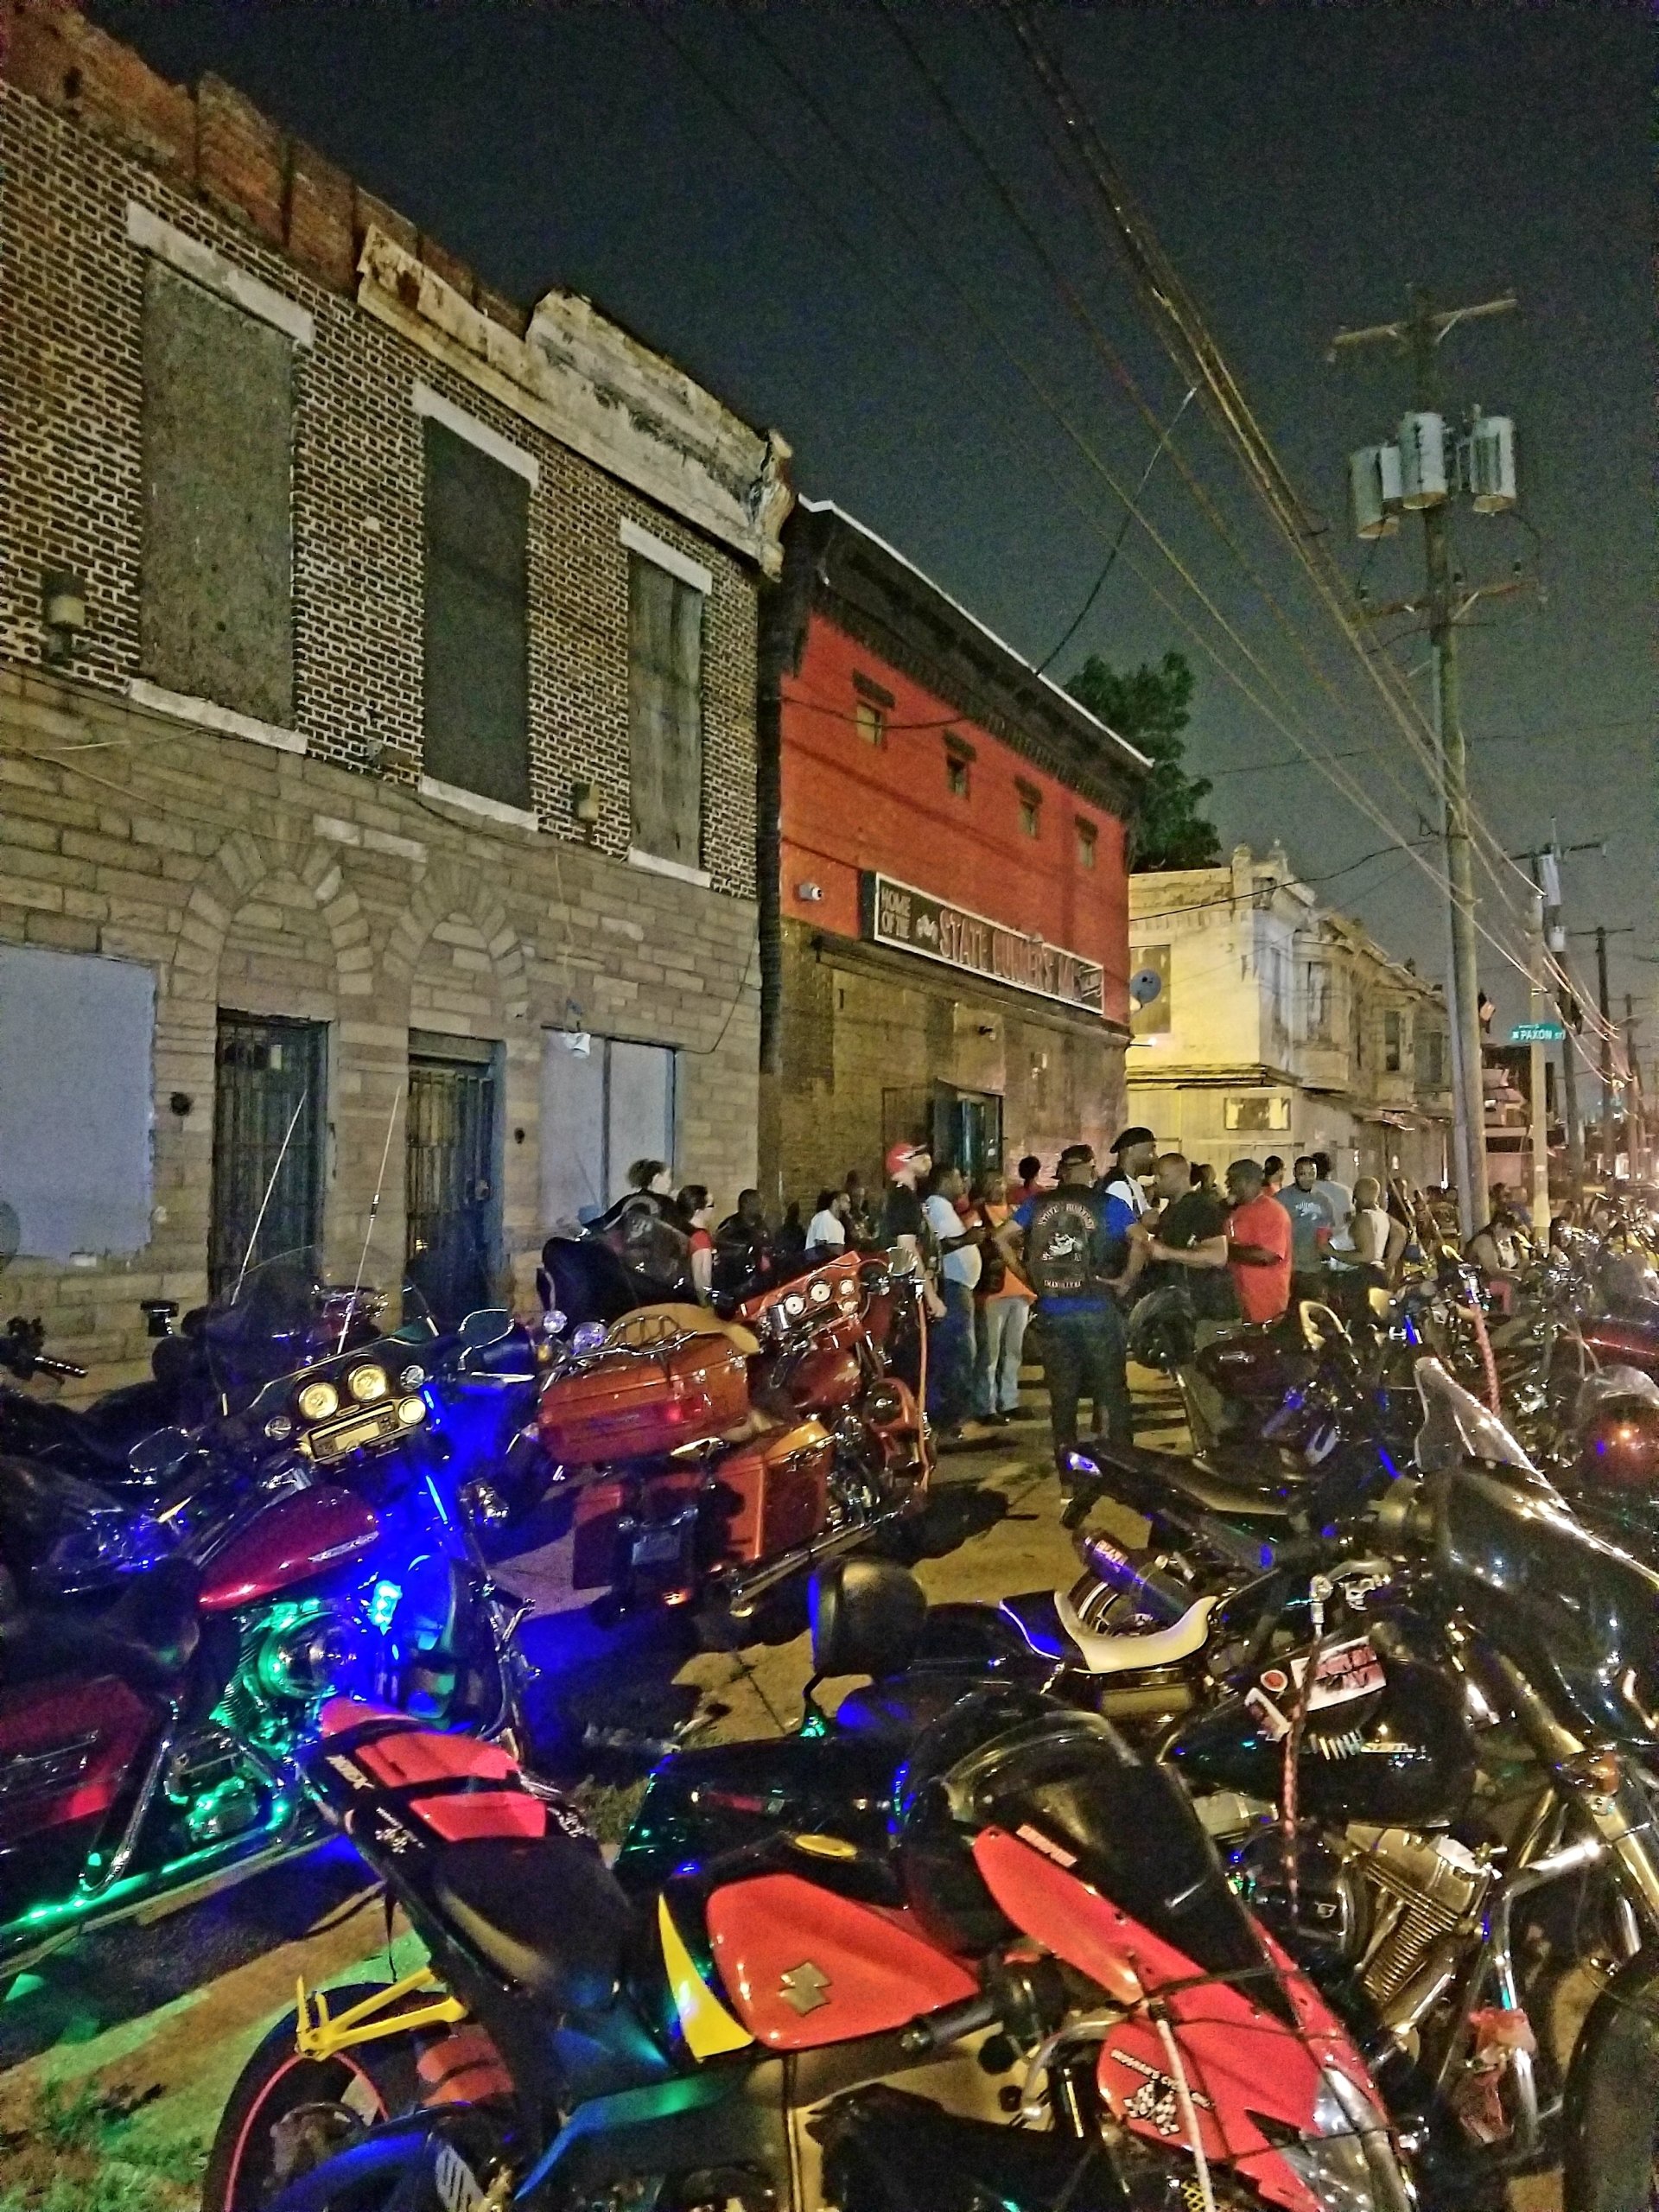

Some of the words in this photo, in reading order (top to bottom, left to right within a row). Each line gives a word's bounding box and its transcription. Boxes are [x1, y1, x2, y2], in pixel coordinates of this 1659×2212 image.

[880, 887, 911, 918] HOME
[881, 910, 895, 934] OF
[939, 908, 988, 971] STATE
[1520, 1028, 1553, 1040] PAXON
